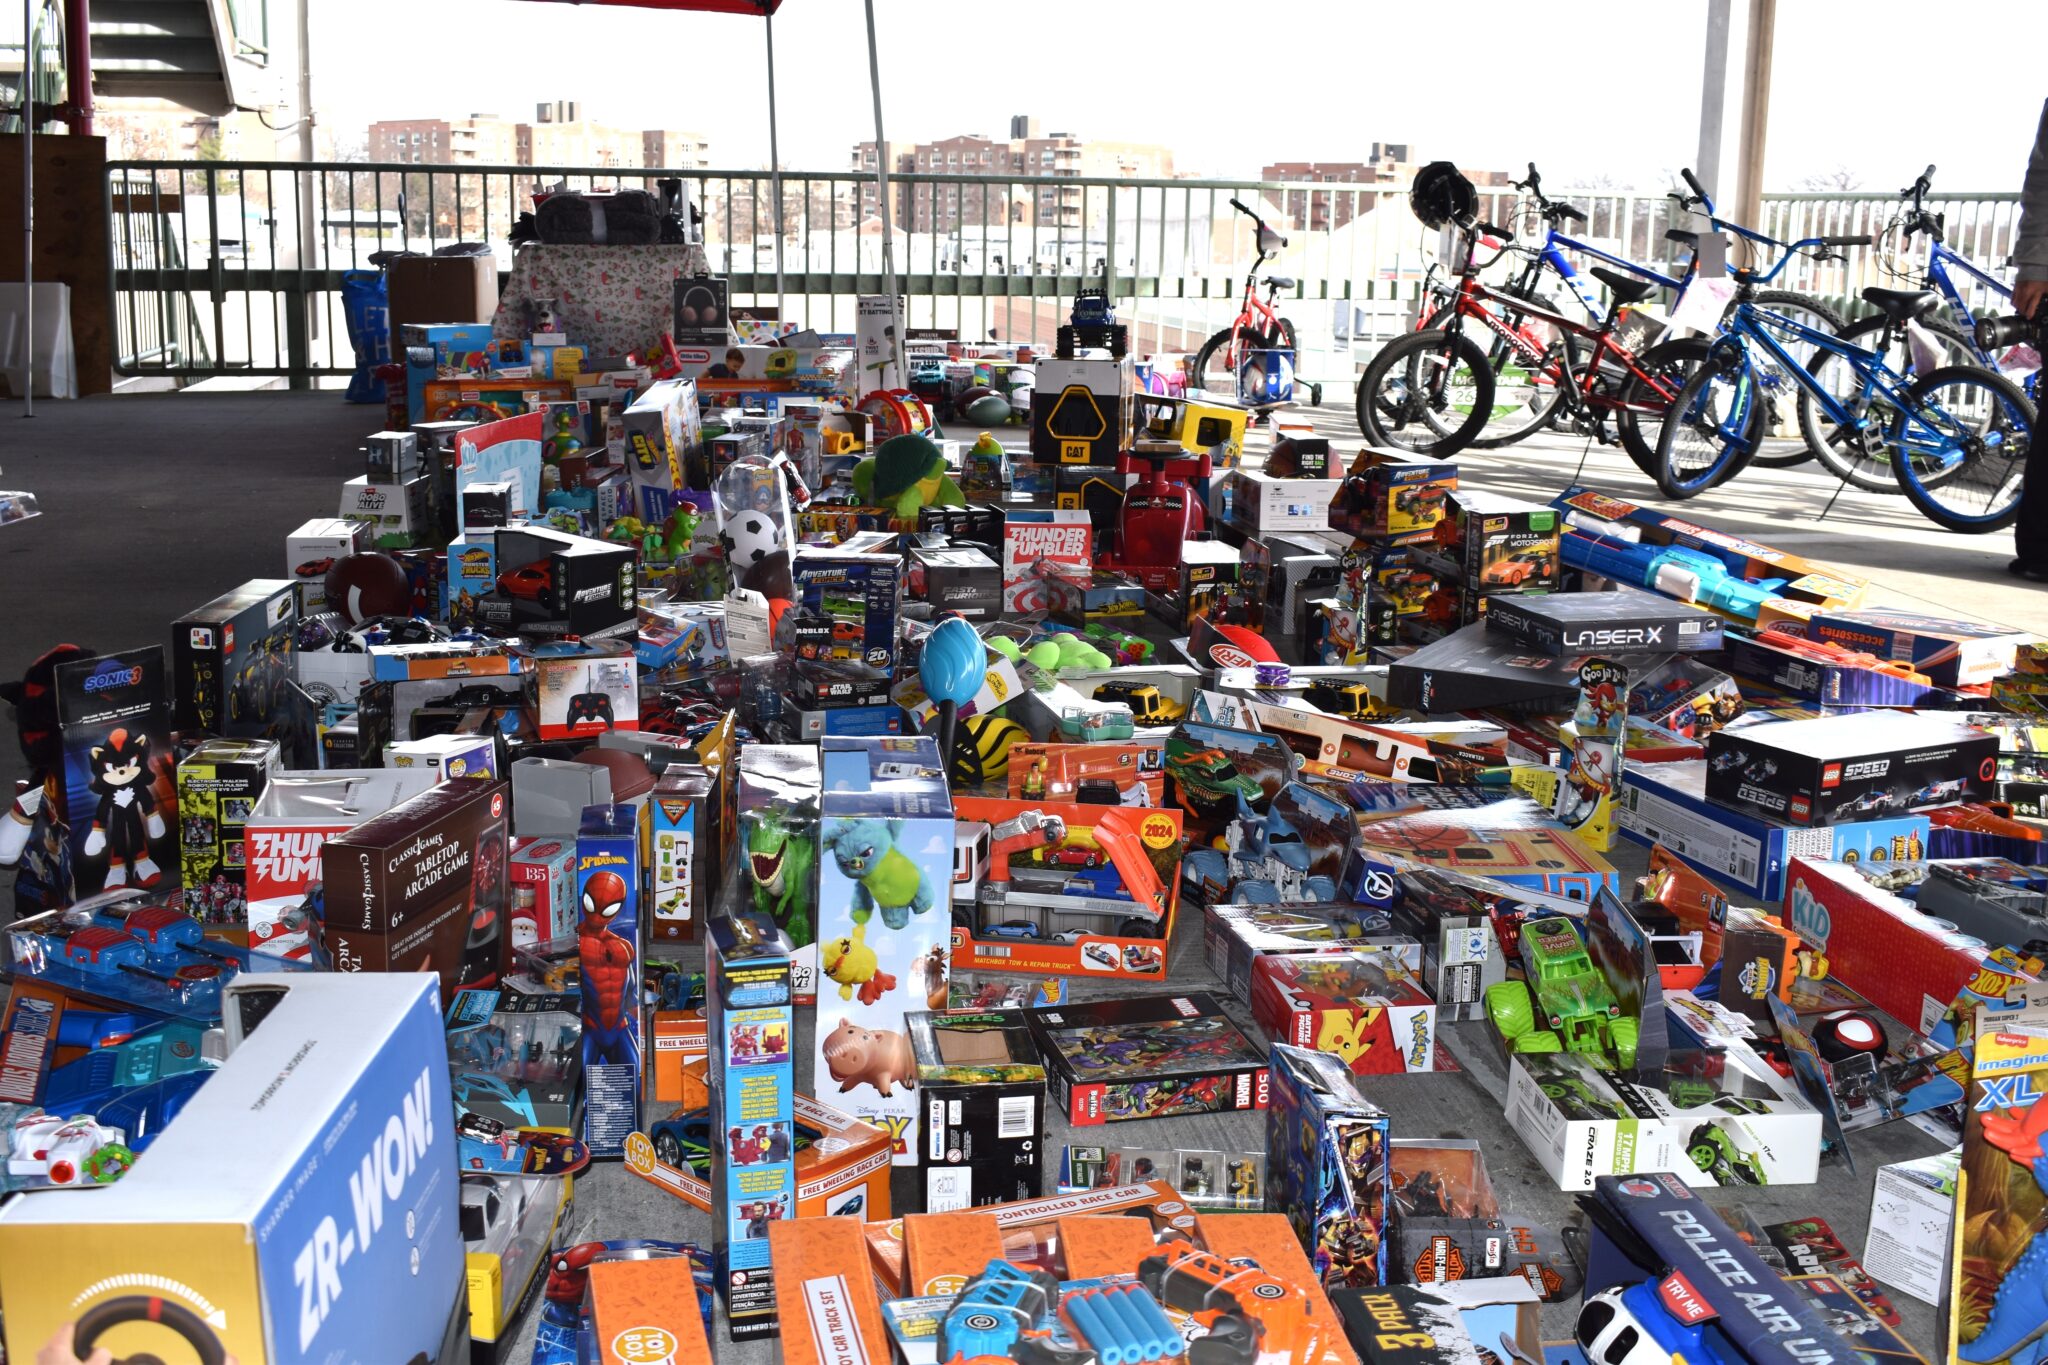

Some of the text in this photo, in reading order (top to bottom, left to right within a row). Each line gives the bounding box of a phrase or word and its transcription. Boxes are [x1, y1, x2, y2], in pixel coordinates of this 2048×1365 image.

[1066, 447, 1084, 458] CAT
[1510, 539, 1557, 548] MOTORSPORT
[798, 569, 848, 582] ADVENTURE
[1562, 627, 1662, 647] LASER X
[868, 649, 888, 661] 20
[84, 670, 131, 690] SONIC
[830, 688, 852, 697] WARS
[1843, 760, 1890, 778] SPEED
[1145, 823, 1173, 838] 2024
[415, 841, 459, 877] TABLETOP
[404, 851, 469, 900] ARCADE GAME
[525, 867, 546, 881] 135
[391, 912, 404, 928] 6+
[974, 957, 1006, 966] MATCHBOX
[1009, 958, 1020, 966] TOW
[1028, 960, 1050, 969] REPAIR
[1298, 1014, 1306, 1042] FIGURE
[1304, 1014, 1312, 1044] BATTLE
[659, 1038, 707, 1049] FREE WHEELI
[1236, 1073, 1251, 1109] MARVEL
[1257, 1073, 1269, 1104] 500
[1973, 1075, 2047, 1111] XL
[803, 1105, 846, 1125] RACE CAR
[1089, 1090, 1098, 1118] Buffalo
[1583, 1126, 1596, 1187] CRAZE 2.0
[680, 1178, 694, 1191] FREE
[803, 1154, 888, 1197] FREE WHEELING RACE CAR
[1083, 1193, 1114, 1210] RACE
[1115, 1187, 1141, 1203] CAR
[1488, 1240, 1497, 1265] Maisto
[1659, 1210, 1757, 1288] POLICE
[1733, 1291, 1802, 1335] AIR
[1665, 1278, 1703, 1318] TRY ME
[820, 1290, 845, 1351] SET TRACK CAR
[1361, 1293, 1407, 1328] PACK
[732, 1323, 769, 1333] TITAN HERO
[624, 1332, 643, 1358] BOX
[645, 1331, 668, 1356] TOY
[1376, 1331, 1436, 1353] 3
